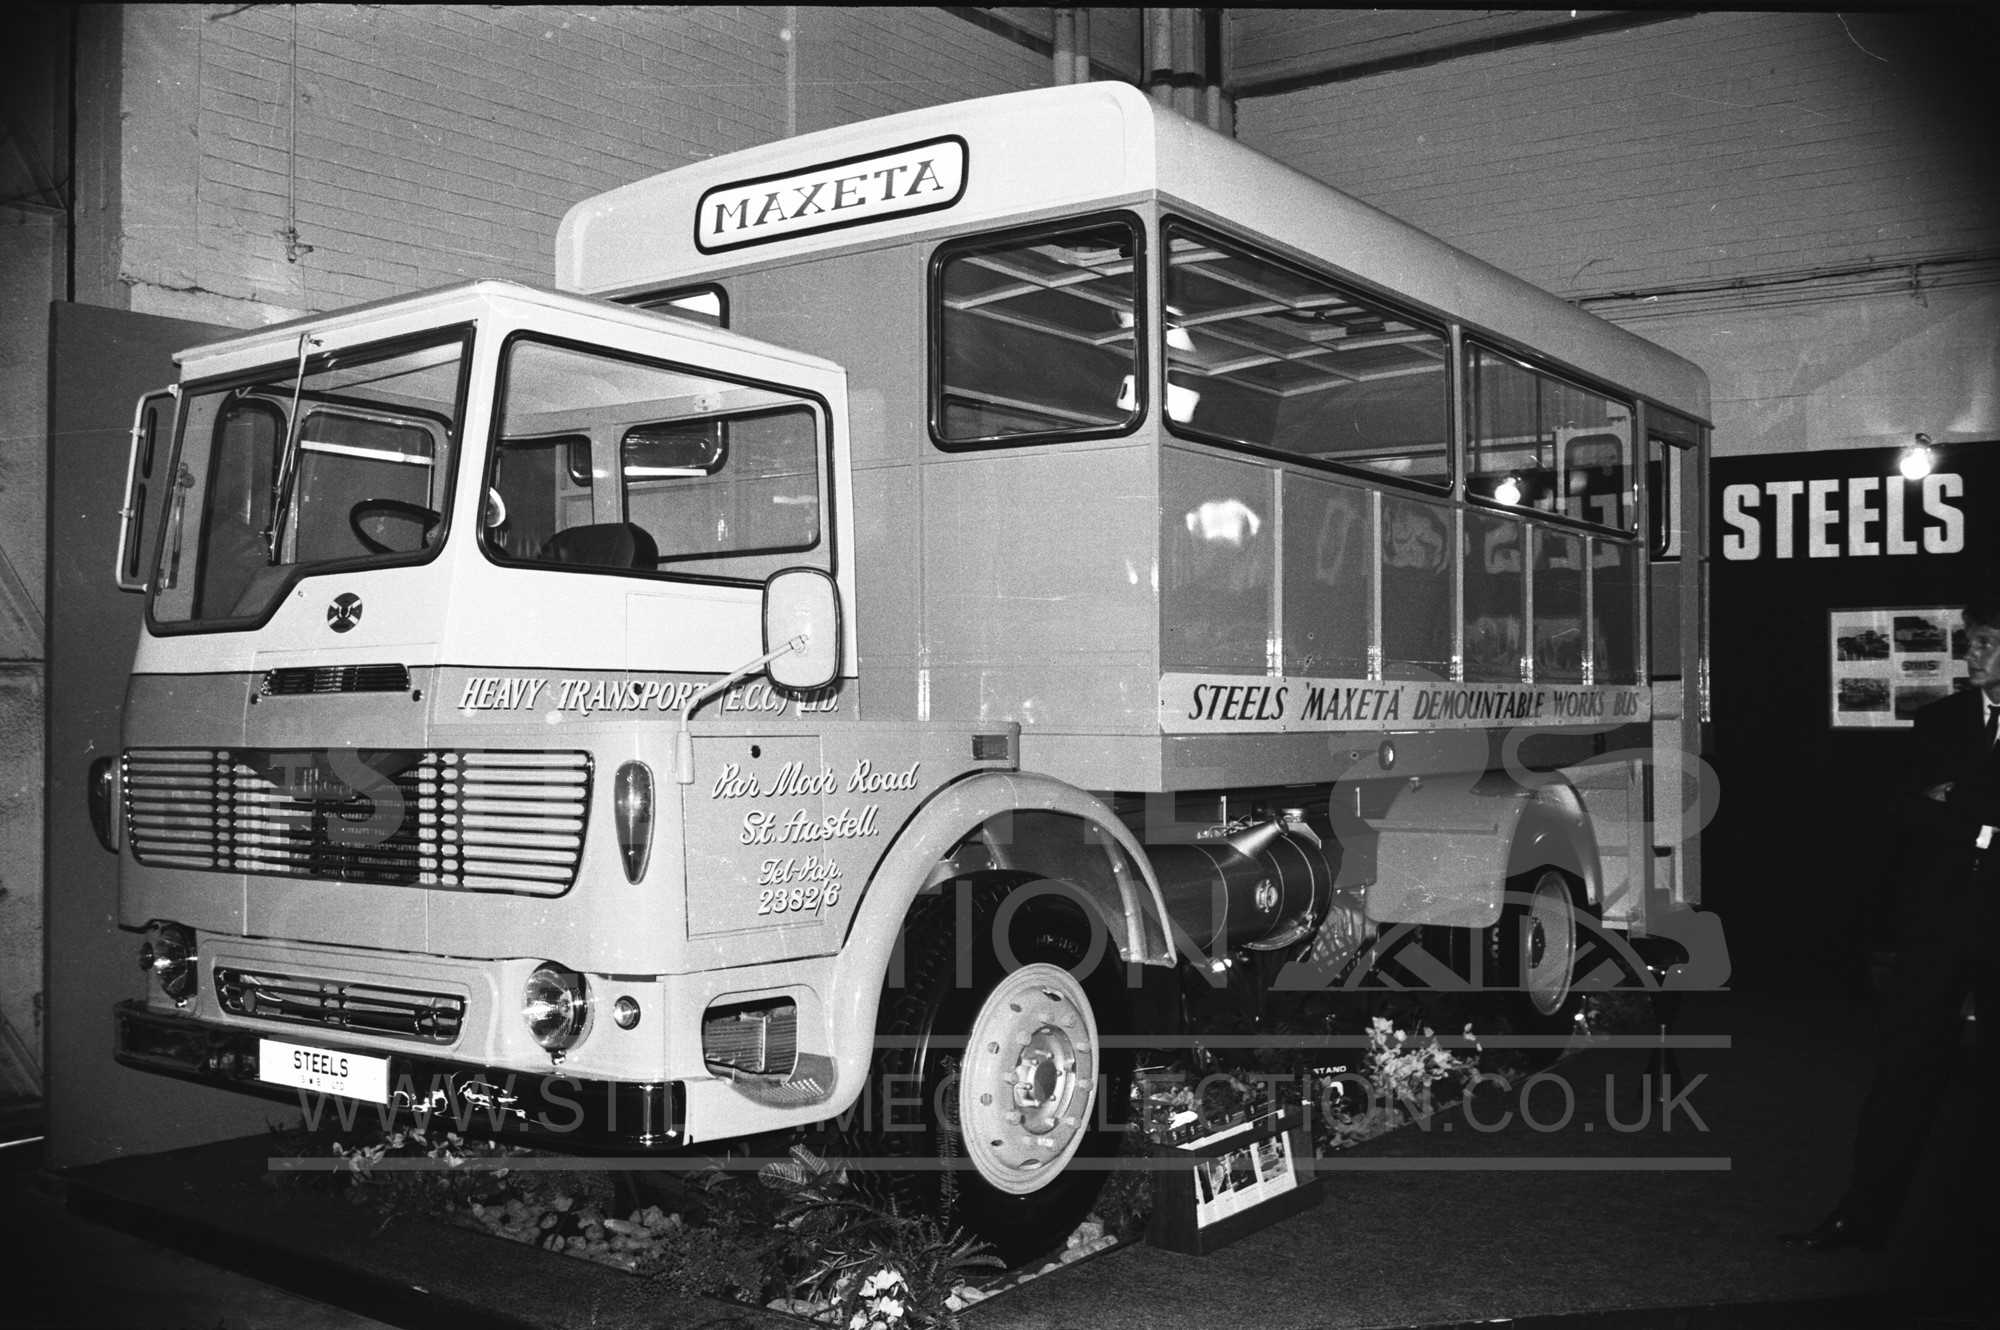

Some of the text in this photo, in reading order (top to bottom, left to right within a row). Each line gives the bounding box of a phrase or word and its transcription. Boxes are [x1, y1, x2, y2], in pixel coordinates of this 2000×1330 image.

[712, 158, 944, 235] MAXETA
[1722, 473, 1965, 561] STEELS
[457, 677, 548, 710] HEAVY
[1188, 682, 1639, 720] STEELS 'MAXETA' DEMOUNTABLE WORKS BUS
[712, 759, 920, 799] Par Moor Road
[739, 804, 879, 845] St. Austell.
[758, 880, 841, 917] 2382/6
[293, 1050, 348, 1077] STEELS
